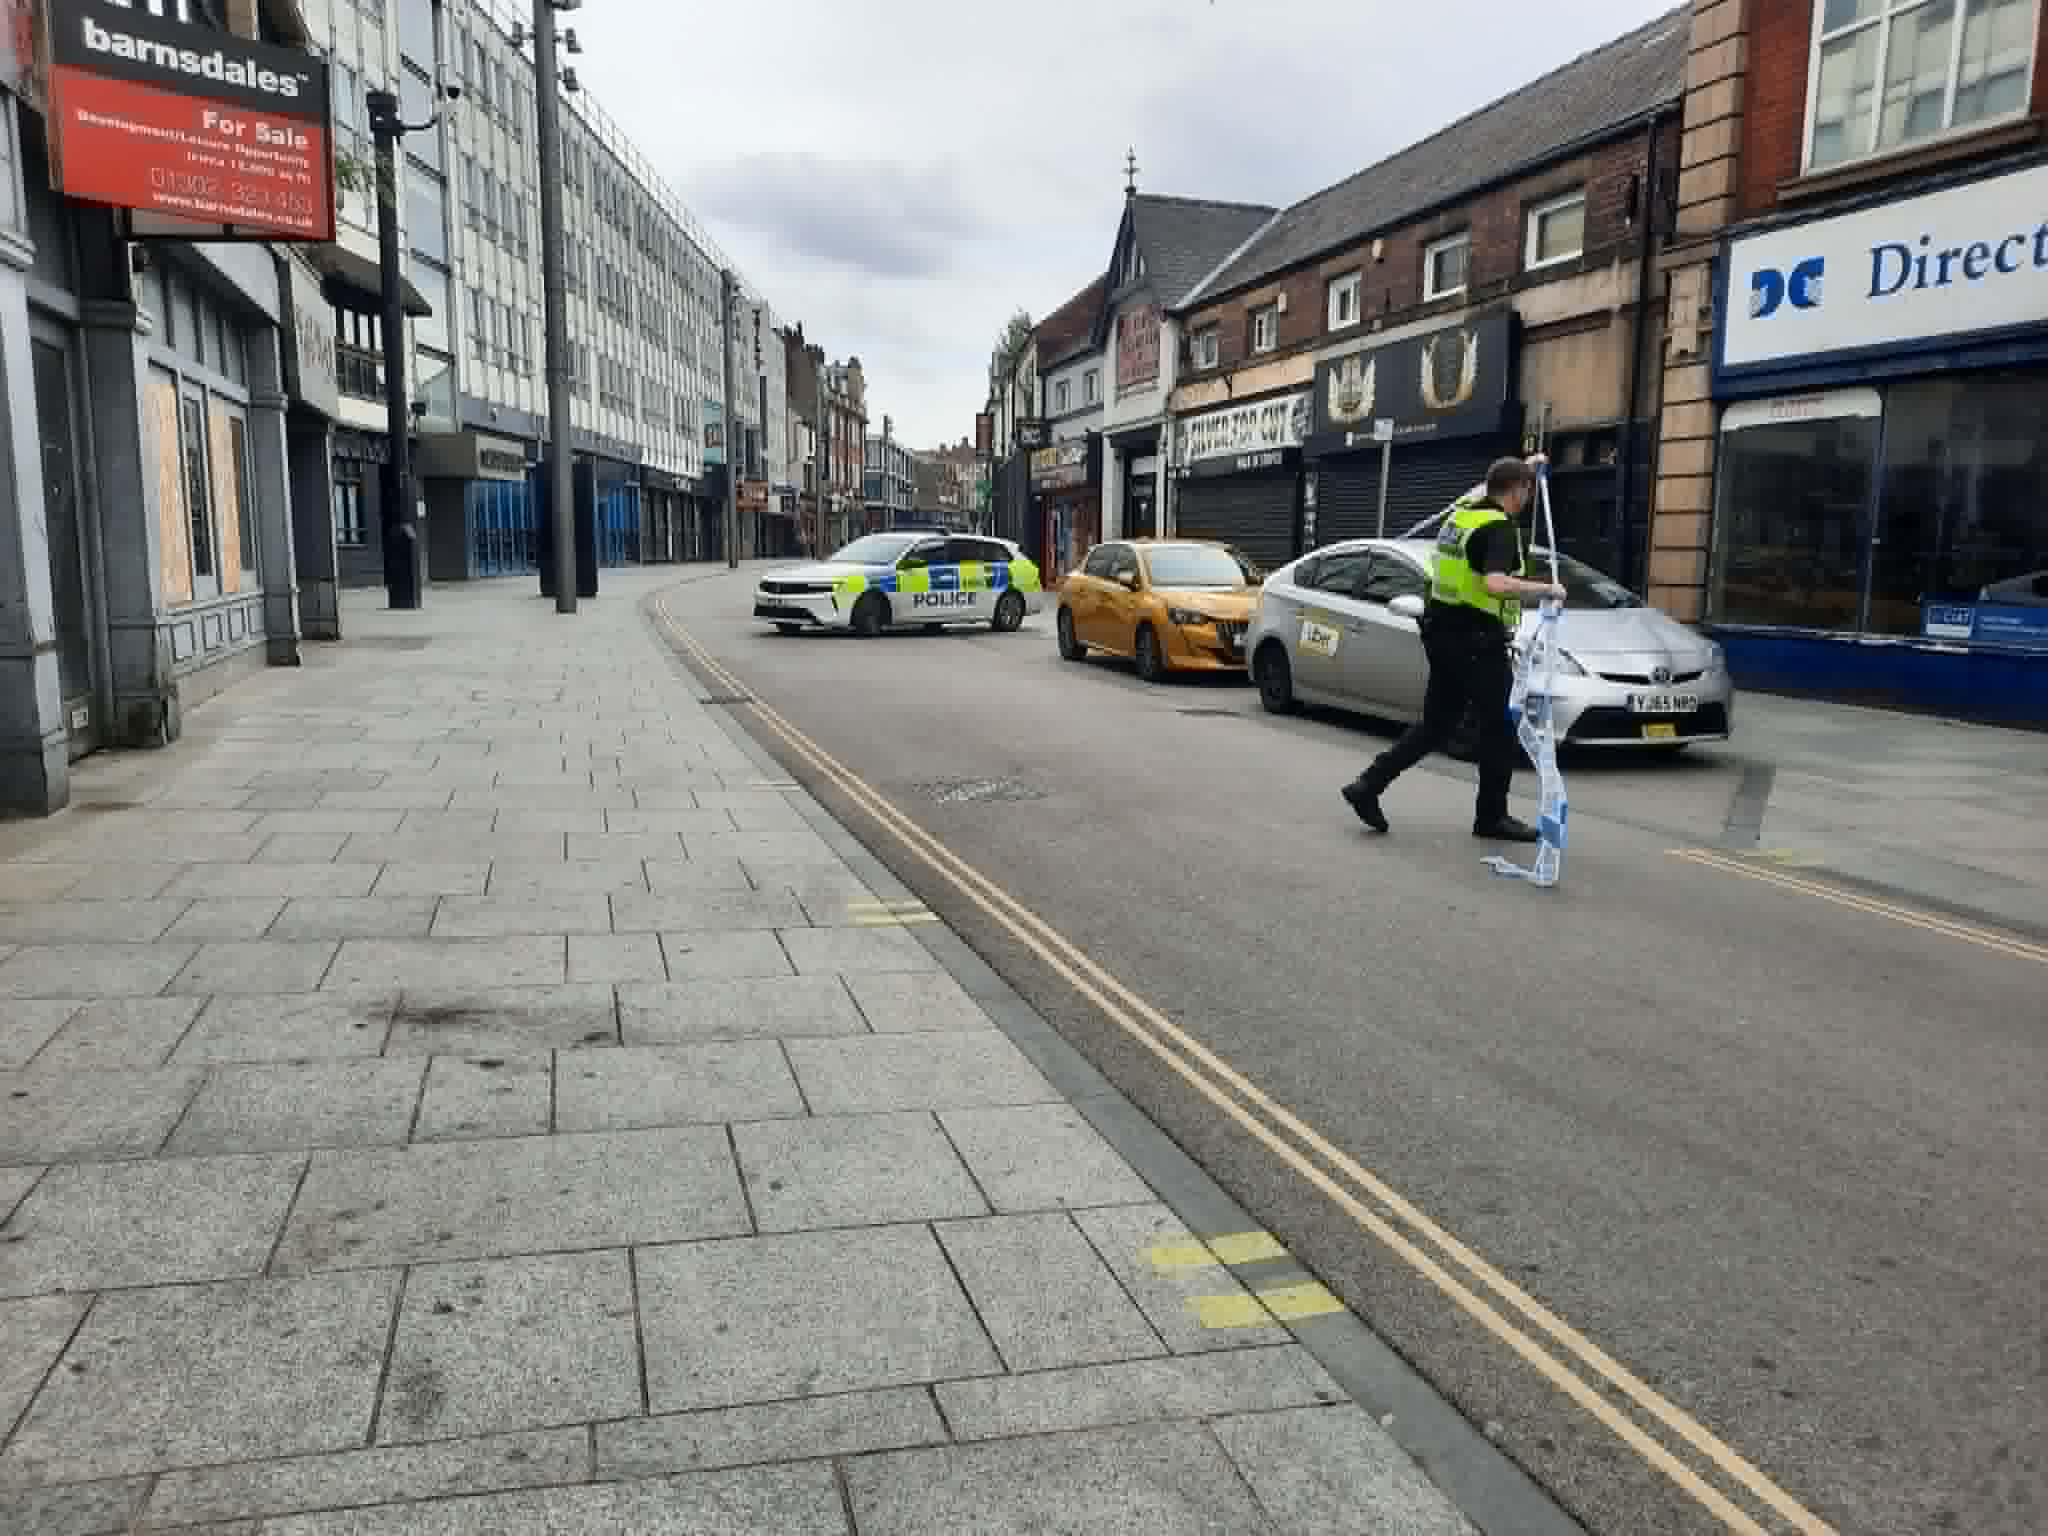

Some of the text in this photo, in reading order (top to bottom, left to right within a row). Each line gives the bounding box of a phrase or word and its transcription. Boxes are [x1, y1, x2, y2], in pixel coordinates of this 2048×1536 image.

[202, 108, 309, 151] For Sale
[1864, 220, 2048, 303] Direct
[912, 590, 977, 609] POLICE
